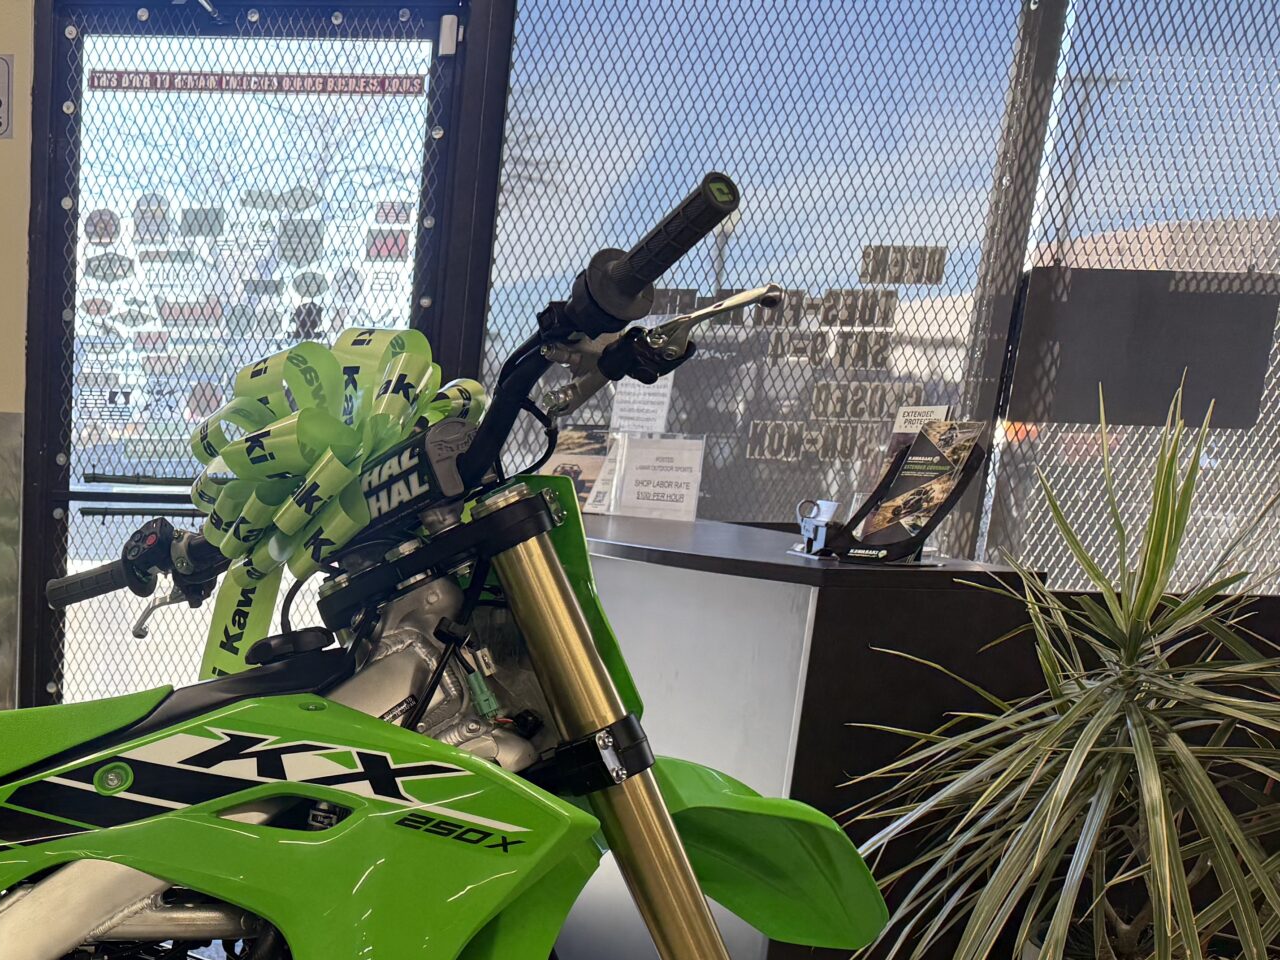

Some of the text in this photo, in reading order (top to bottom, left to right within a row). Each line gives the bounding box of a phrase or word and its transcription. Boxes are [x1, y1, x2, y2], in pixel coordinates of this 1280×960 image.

[634, 479, 691, 490] SHOP LABOR RATE
[177, 731, 467, 803] KX
[394, 812, 527, 854] 250X
